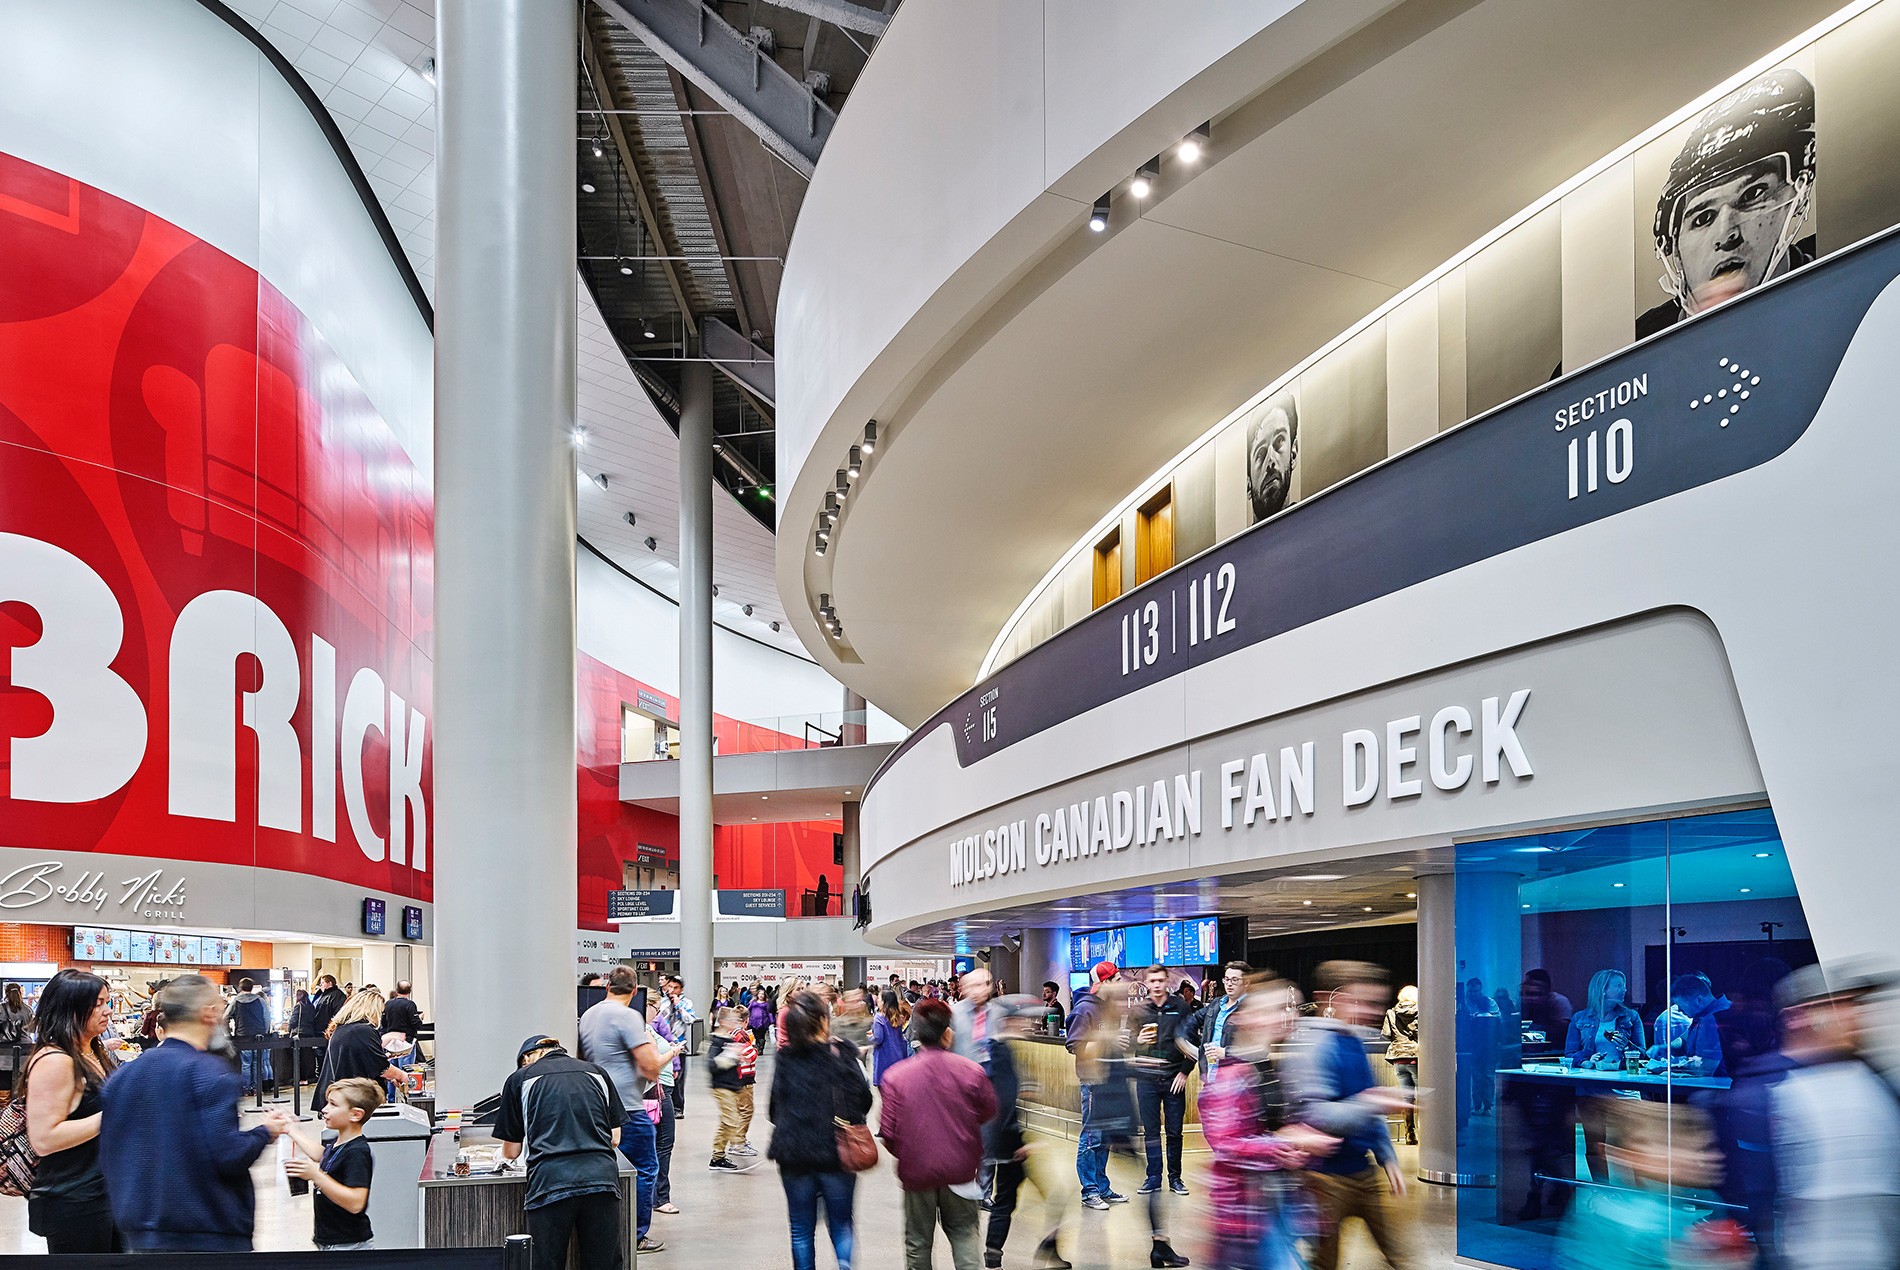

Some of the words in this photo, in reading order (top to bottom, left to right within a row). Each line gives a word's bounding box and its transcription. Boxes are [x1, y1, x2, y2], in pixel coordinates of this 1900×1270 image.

[1554, 373, 1648, 432] SECTION
[1568, 418, 1633, 500] 110
[1121, 600, 1159, 676] 113
[1189, 562, 1236, 647] 112
[0, 531, 426, 872] BRICK
[980, 687, 999, 708] SECTION
[983, 706, 997, 743] 115
[950, 820, 1026, 887] MOLSON
[1034, 771, 1201, 866] CANADIAN
[1220, 741, 1315, 829] FAN
[1343, 689, 1534, 807] DECK
[0, 861, 108, 911] Bobby
[119, 869, 186, 912] Nick's
[144, 910, 186, 919] GRILL
